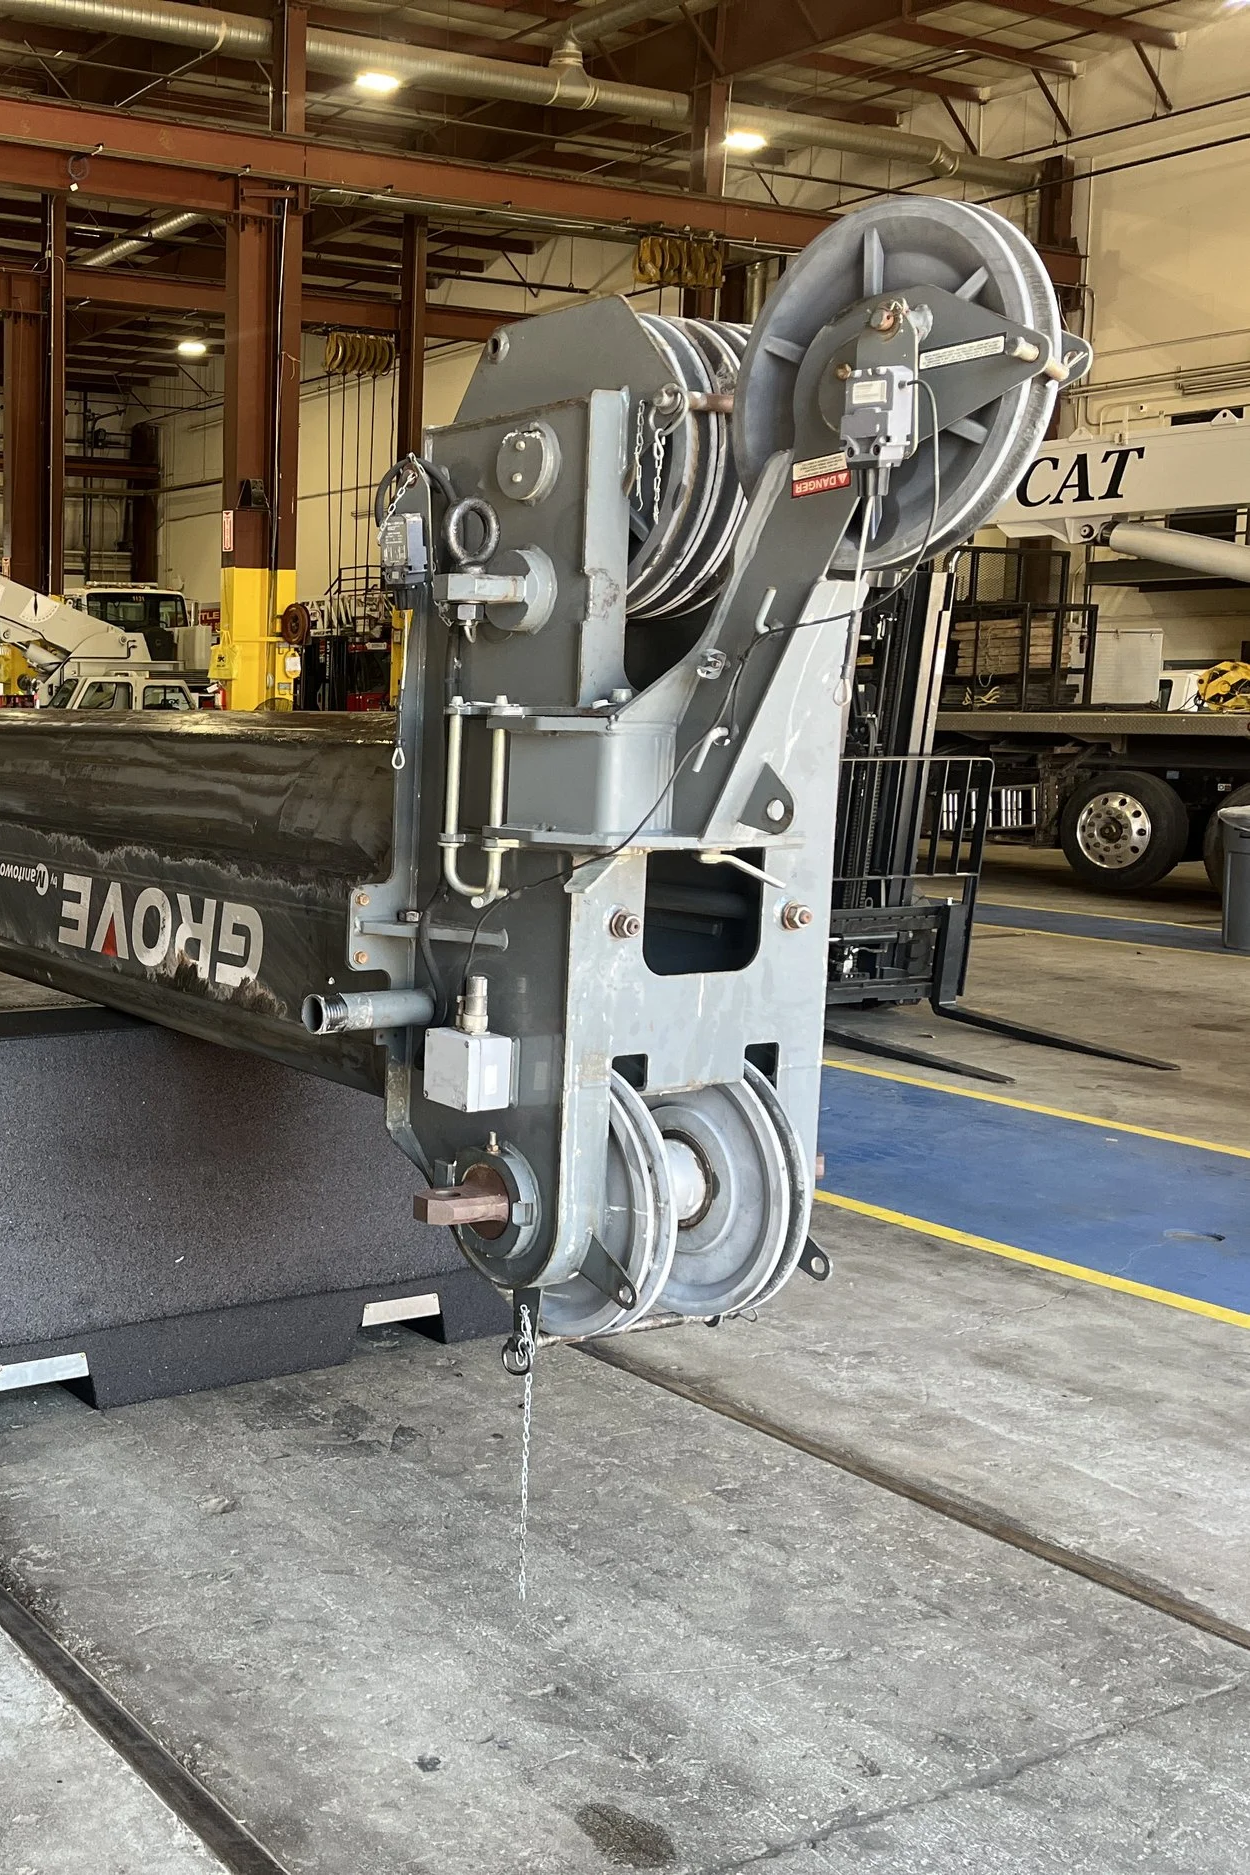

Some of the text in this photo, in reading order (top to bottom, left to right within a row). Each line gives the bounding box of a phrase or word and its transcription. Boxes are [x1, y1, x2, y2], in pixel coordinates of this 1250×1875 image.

[795, 475, 837, 494] DANGER
[1016, 447, 1145, 507] CAT
[50, 873, 58, 889] by
[58, 873, 264, 988] GROVE
